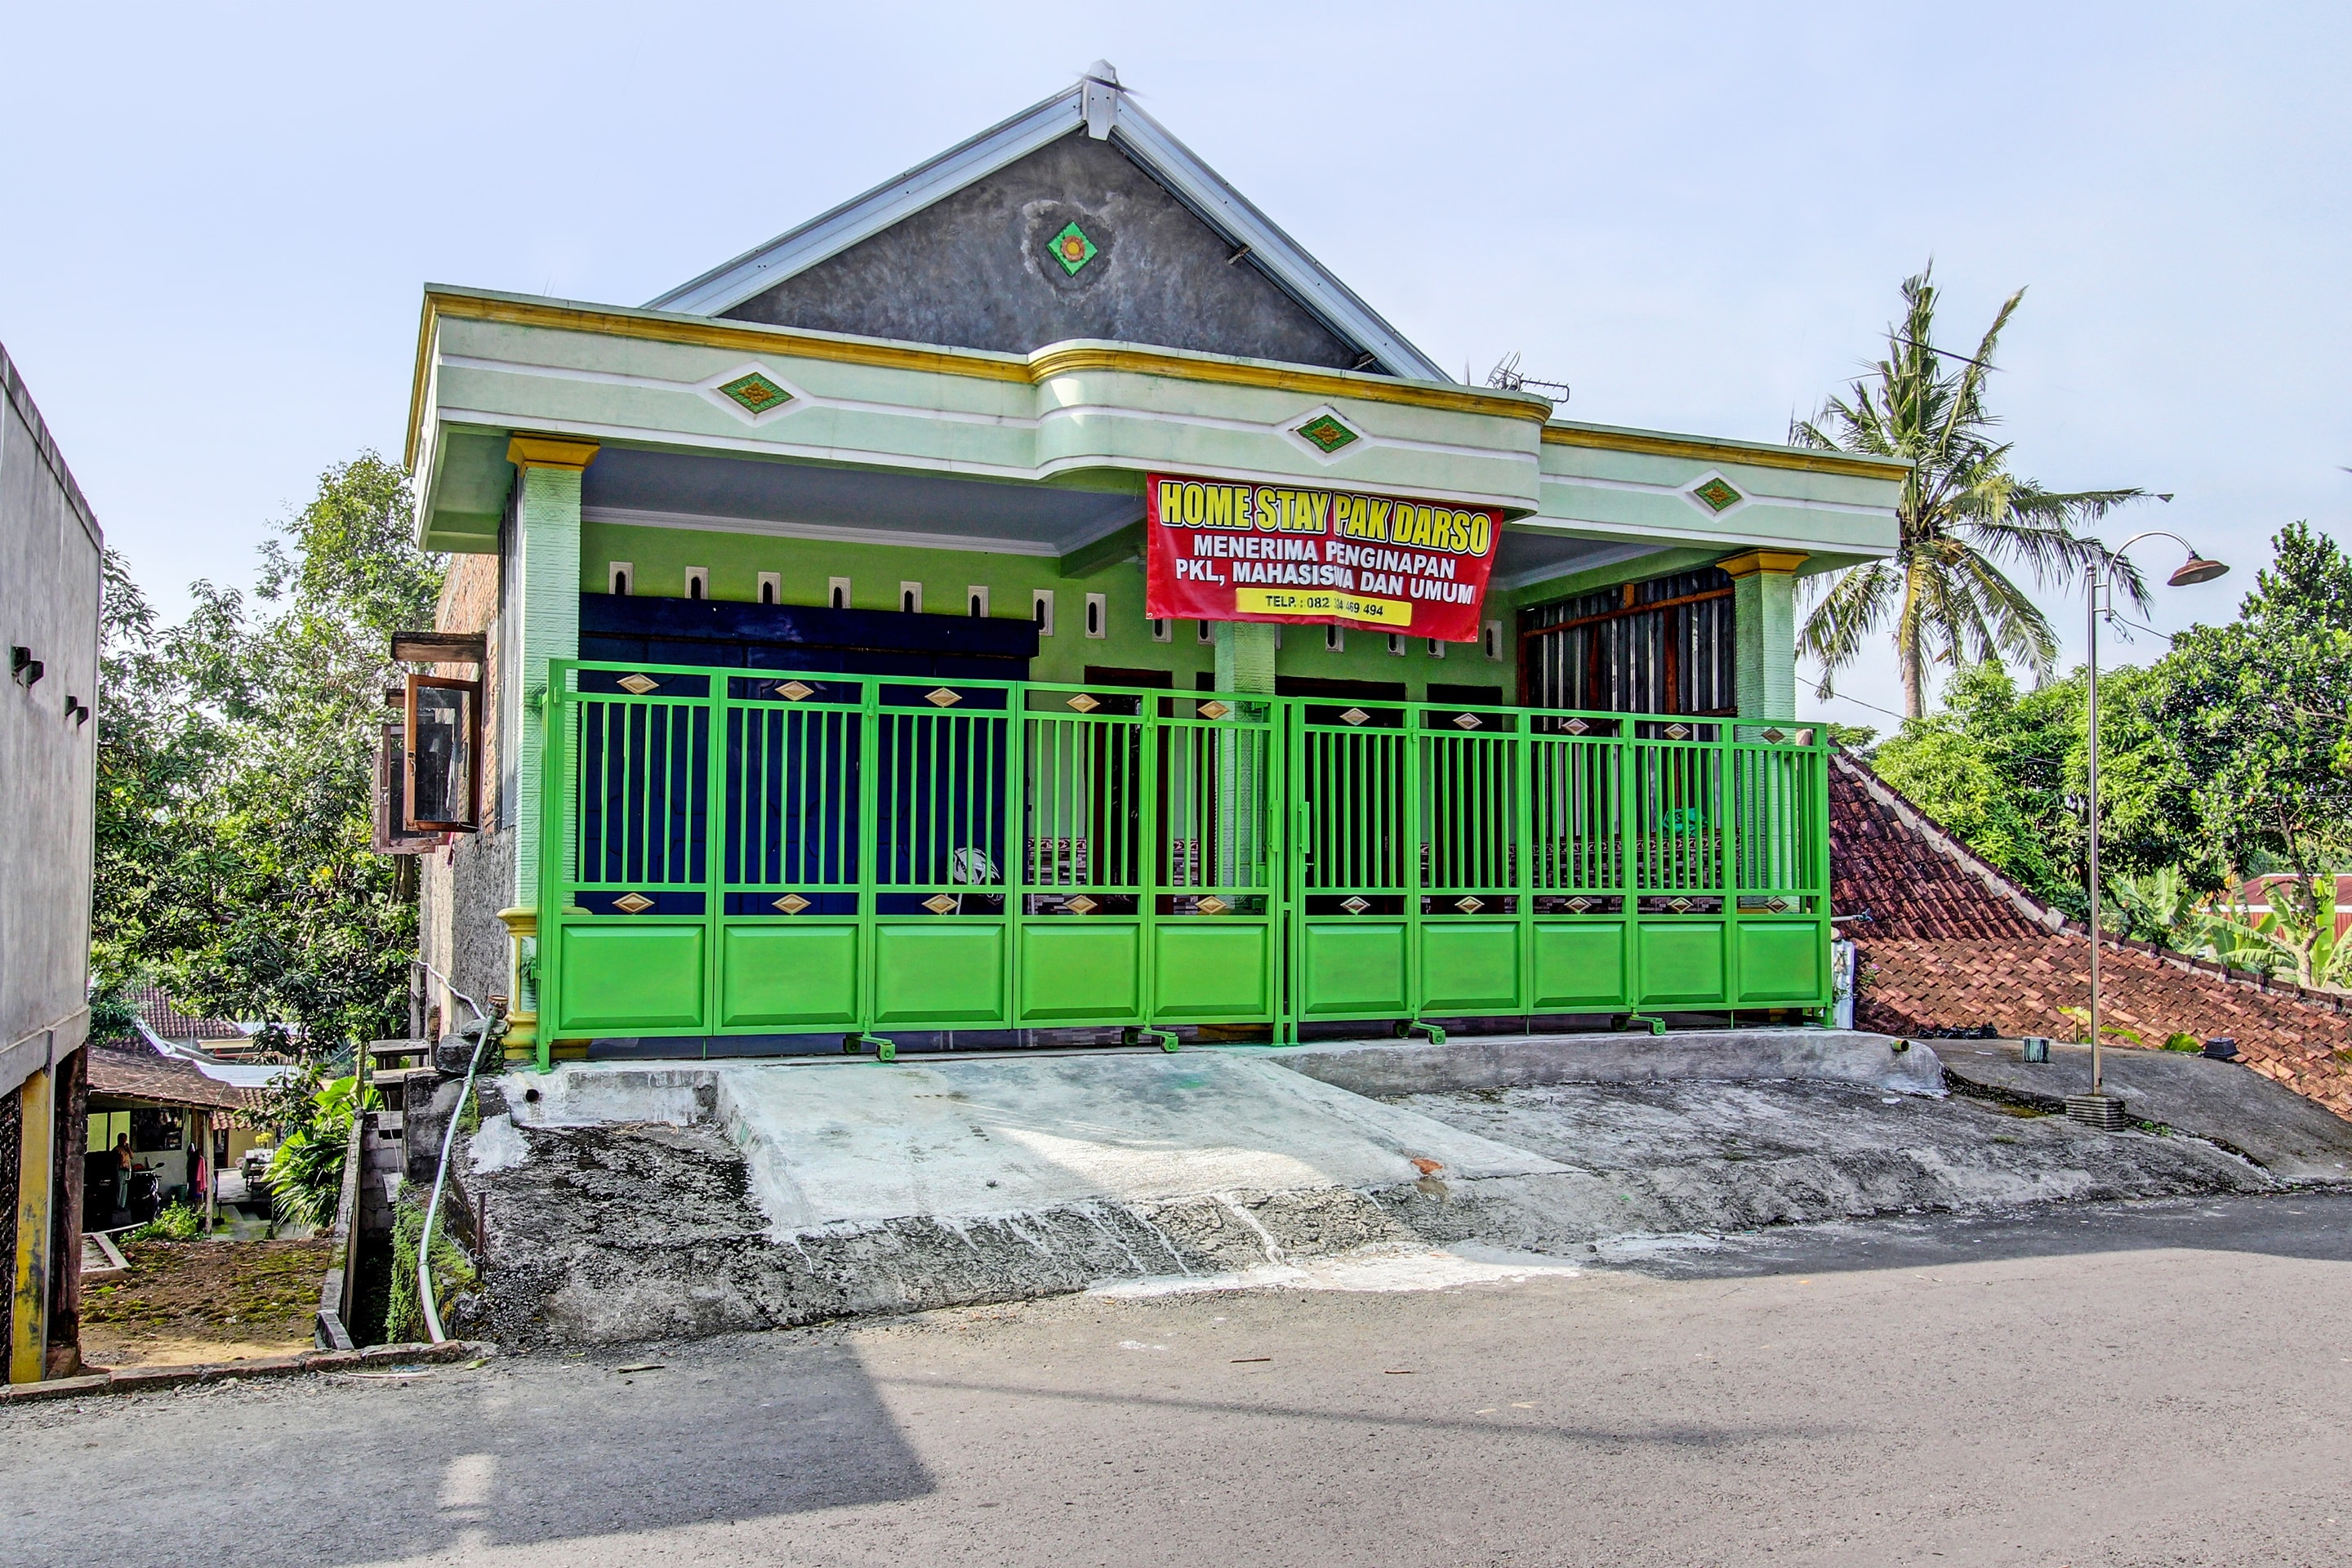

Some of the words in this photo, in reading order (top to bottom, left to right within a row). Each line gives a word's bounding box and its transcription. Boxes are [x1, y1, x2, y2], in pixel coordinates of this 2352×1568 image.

[1160, 481, 1251, 529] HOME
[1255, 486, 1330, 533] STAY
[1334, 492, 1391, 544] PAK
[1391, 501, 1490, 556] DARSO
[1194, 535, 1317, 561] MENERIMA
[1325, 541, 1455, 579] PENGINAPAN
[1175, 559, 1224, 586] PKL,
[1232, 561, 1353, 589] MAHASISWA
[1360, 572, 1403, 597] DAN
[1410, 578, 1474, 604] UMUM
[1307, 597, 1330, 608] 082
[1363, 604, 1383, 616] 494
